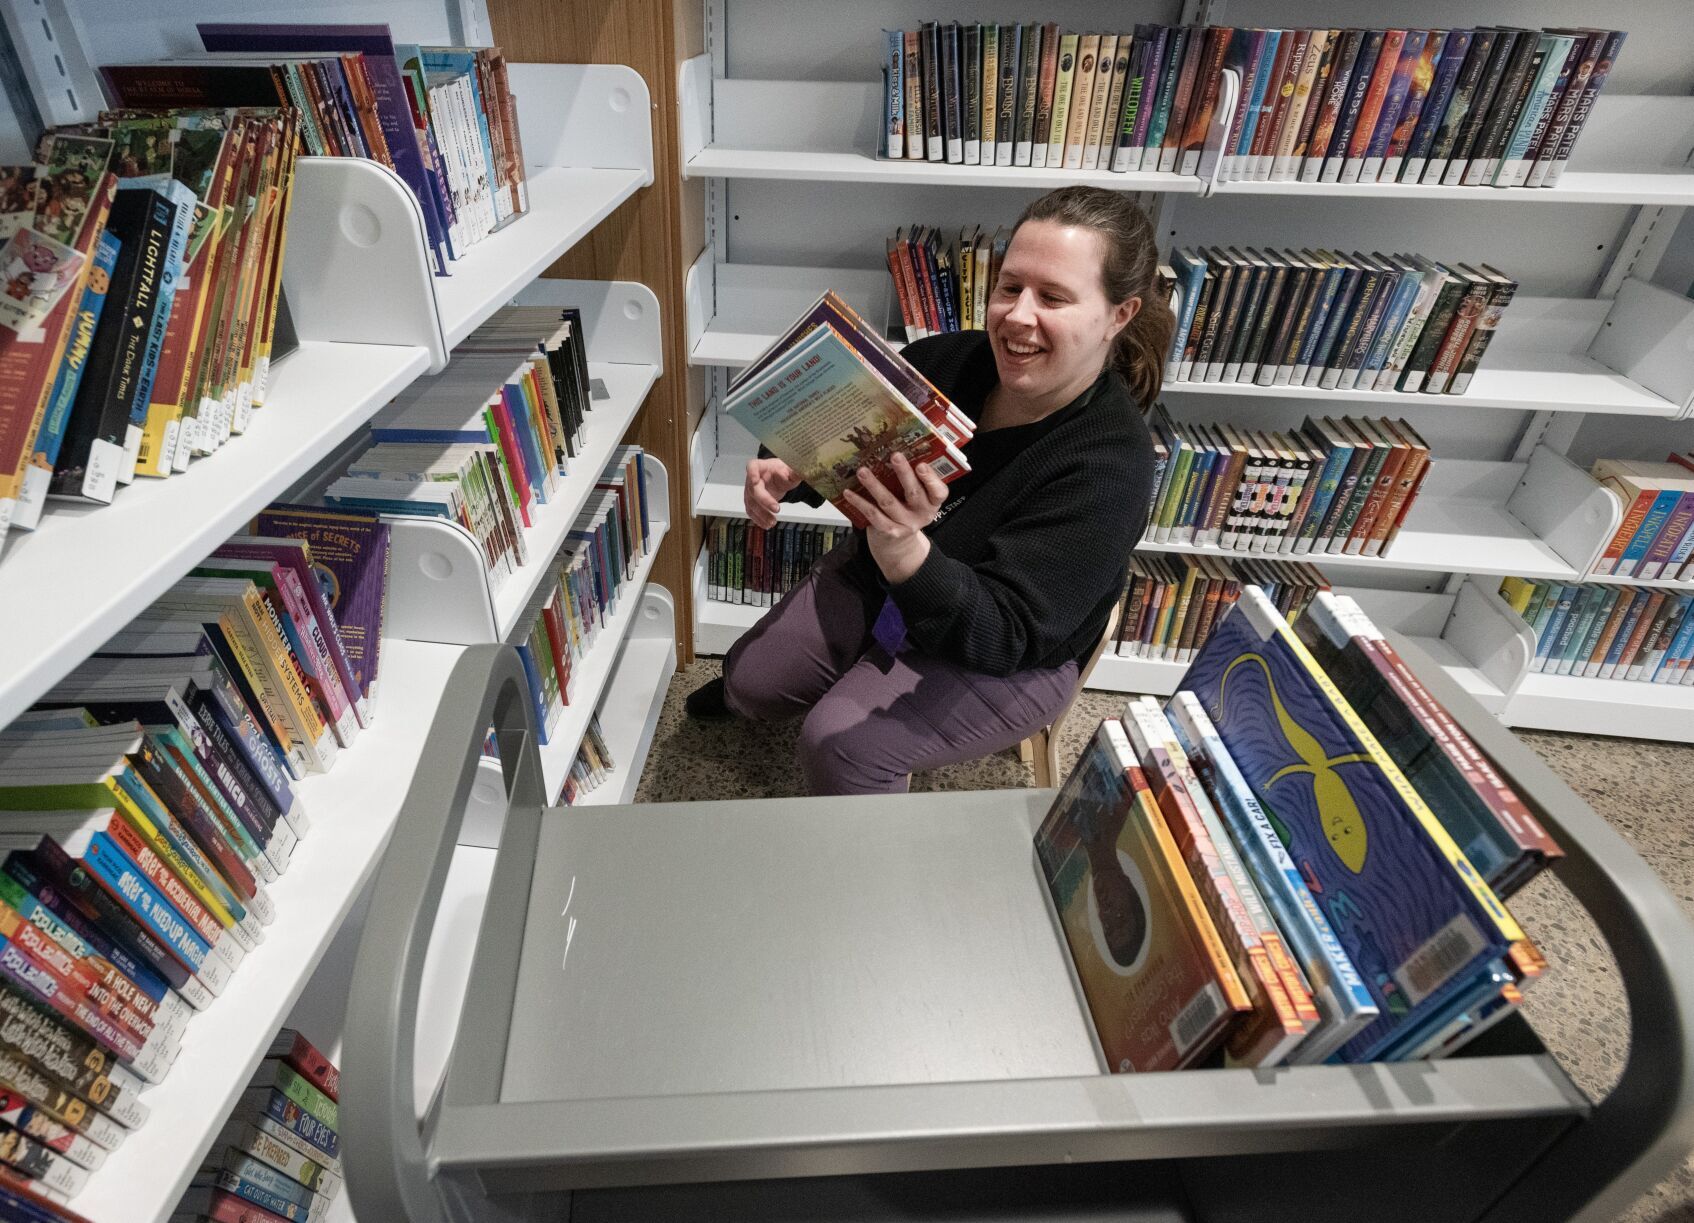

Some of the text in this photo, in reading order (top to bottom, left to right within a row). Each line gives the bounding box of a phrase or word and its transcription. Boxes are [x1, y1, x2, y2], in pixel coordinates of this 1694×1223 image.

[1288, 41, 1306, 76] Ripley
[1305, 44, 1322, 75] Zeus
[1568, 43, 1579, 62] CHARI
[1589, 38, 1600, 58] CHARI
[1000, 75, 1014, 118] ENDLING
[1023, 76, 1036, 117] ENDLING
[1037, 79, 1051, 119] ENDLING
[1244, 72, 1254, 92] RISE
[1327, 80, 1341, 106] HOME
[1348, 73, 1368, 115] LORDS
[891, 96, 899, 116] Milk
[1055, 80, 1067, 133] THE ONE AND ONLY
[1072, 82, 1090, 135] THE ONE AND ONLY
[1090, 81, 1106, 133] THE ONE AND ONLY
[1106, 80, 1121, 134] THE ONE AND ONLY
[1121, 74, 1144, 135] WILLODEEN
[1233, 102, 1246, 131] FLYNN
[1385, 80, 1405, 122] STORM
[1523, 88, 1547, 130] American
[1527, 90, 1558, 150] MARS PATEL
[1539, 87, 1579, 163] MARS PATEL
[1555, 86, 1596, 163] MARS PATEL
[1252, 137, 1261, 154] STORY
[1334, 128, 1350, 158] NIGH
[116, 229, 162, 400] LIGHTFALL THE DARK TIMES
[1347, 275, 1376, 337] ABENI'S SONG
[70, 311, 95, 370] YUMMY
[151, 314, 165, 341] LAST
[1172, 327, 1187, 362] ANDY ZHO
[1449, 318, 1464, 341] SAVES
[1452, 318, 1470, 349] ROSWELL
[145, 341, 159, 367] KIDS
[134, 377, 150, 411] EARTH
[761, 384, 779, 400] LAND
[785, 367, 802, 384] YOUR
[801, 353, 822, 372] LAND!
[931, 494, 966, 522] PPL STAFF
[322, 531, 360, 553] SECRETS
[1611, 508, 1647, 552] INKHEART
[1631, 510, 1667, 555] INKSPELL
[1656, 511, 1689, 558] INKDEATH
[250, 602, 262, 621] NOTT
[254, 600, 264, 615] DAN
[261, 598, 294, 652] MONSTER
[309, 625, 328, 657] CLOUD
[334, 634, 346, 656] CLASS
[1557, 611, 1580, 646] poached
[1641, 617, 1664, 654] spy camp
[1581, 637, 1595, 658] done
[1613, 641, 1624, 656] out
[279, 659, 305, 706] SYSTEMS
[209, 724, 232, 753] TALES
[1423, 715, 1450, 744] CURIE
[1444, 721, 1481, 762] NEWTON
[245, 735, 285, 792] GHOSTS
[1444, 740, 1474, 773] MARIE
[1476, 758, 1505, 791] ISAAC
[212, 762, 249, 808] UNICO
[1244, 795, 1282, 852] FIX A CAR!
[1217, 841, 1262, 915] WILD MUSTANG
[163, 877, 205, 922] ACCIDENTAL
[174, 931, 209, 967] MAGIC
[1319, 927, 1362, 990] MAKER
[1253, 950, 1297, 1022] HISTORY COMICS
[1266, 938, 1308, 1006] HISTORY COMICS
[86, 981, 124, 1015] INTO THE
[102, 968, 157, 1017] A HOLE NEW
[72, 1001, 128, 1048] THE END OF ALL THE
[298, 1111, 331, 1147] FOUR EYES
[262, 1138, 290, 1168] PREPARED
[242, 1183, 286, 1210] CAT OUT OF WATER
